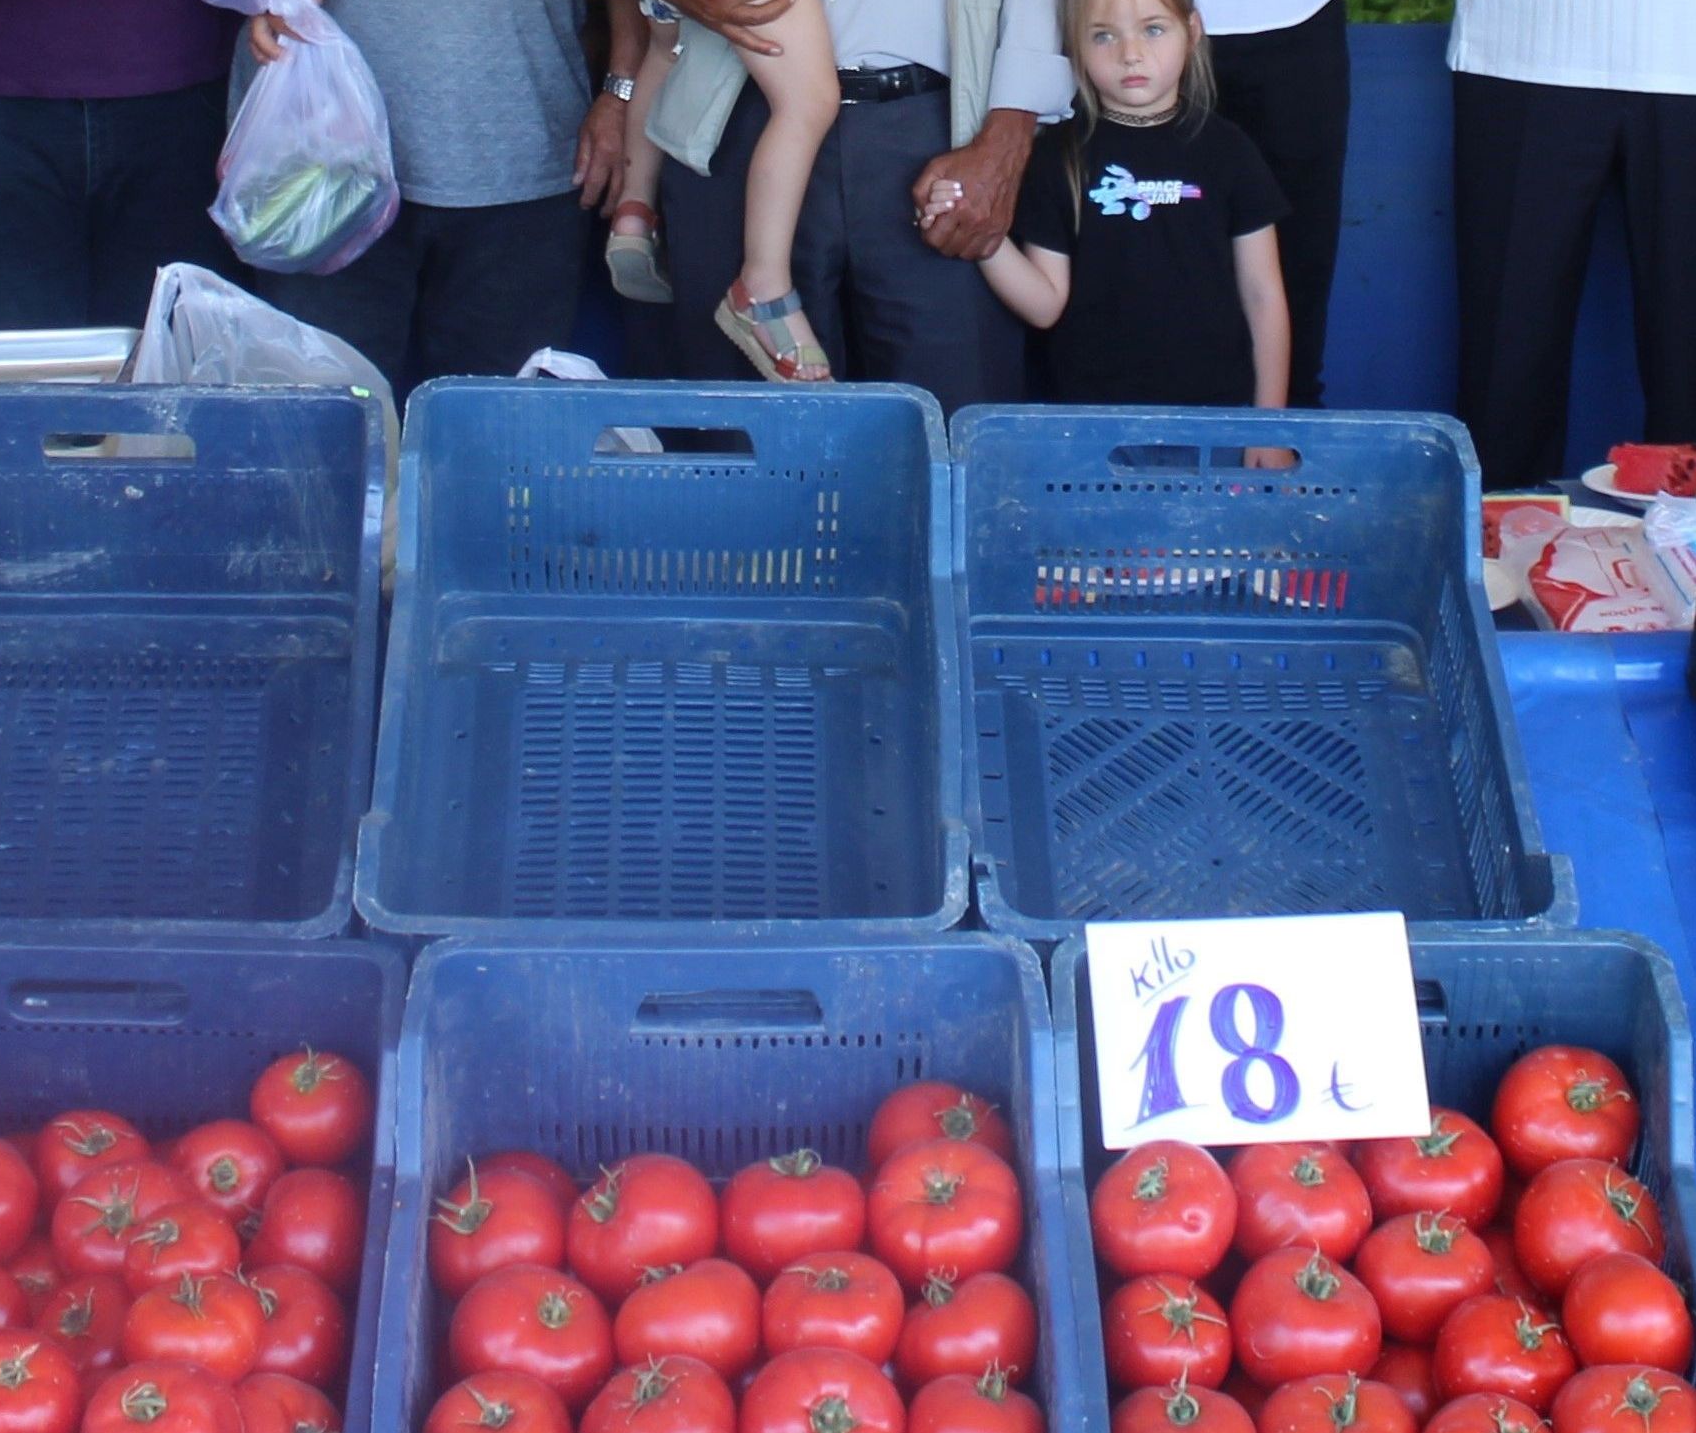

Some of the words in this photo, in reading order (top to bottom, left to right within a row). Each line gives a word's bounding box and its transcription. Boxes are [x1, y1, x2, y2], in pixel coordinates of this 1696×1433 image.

[1137, 180, 1183, 193] SPACE
[1147, 192, 1181, 205] JAM
[1124, 983, 1302, 1132] 18
